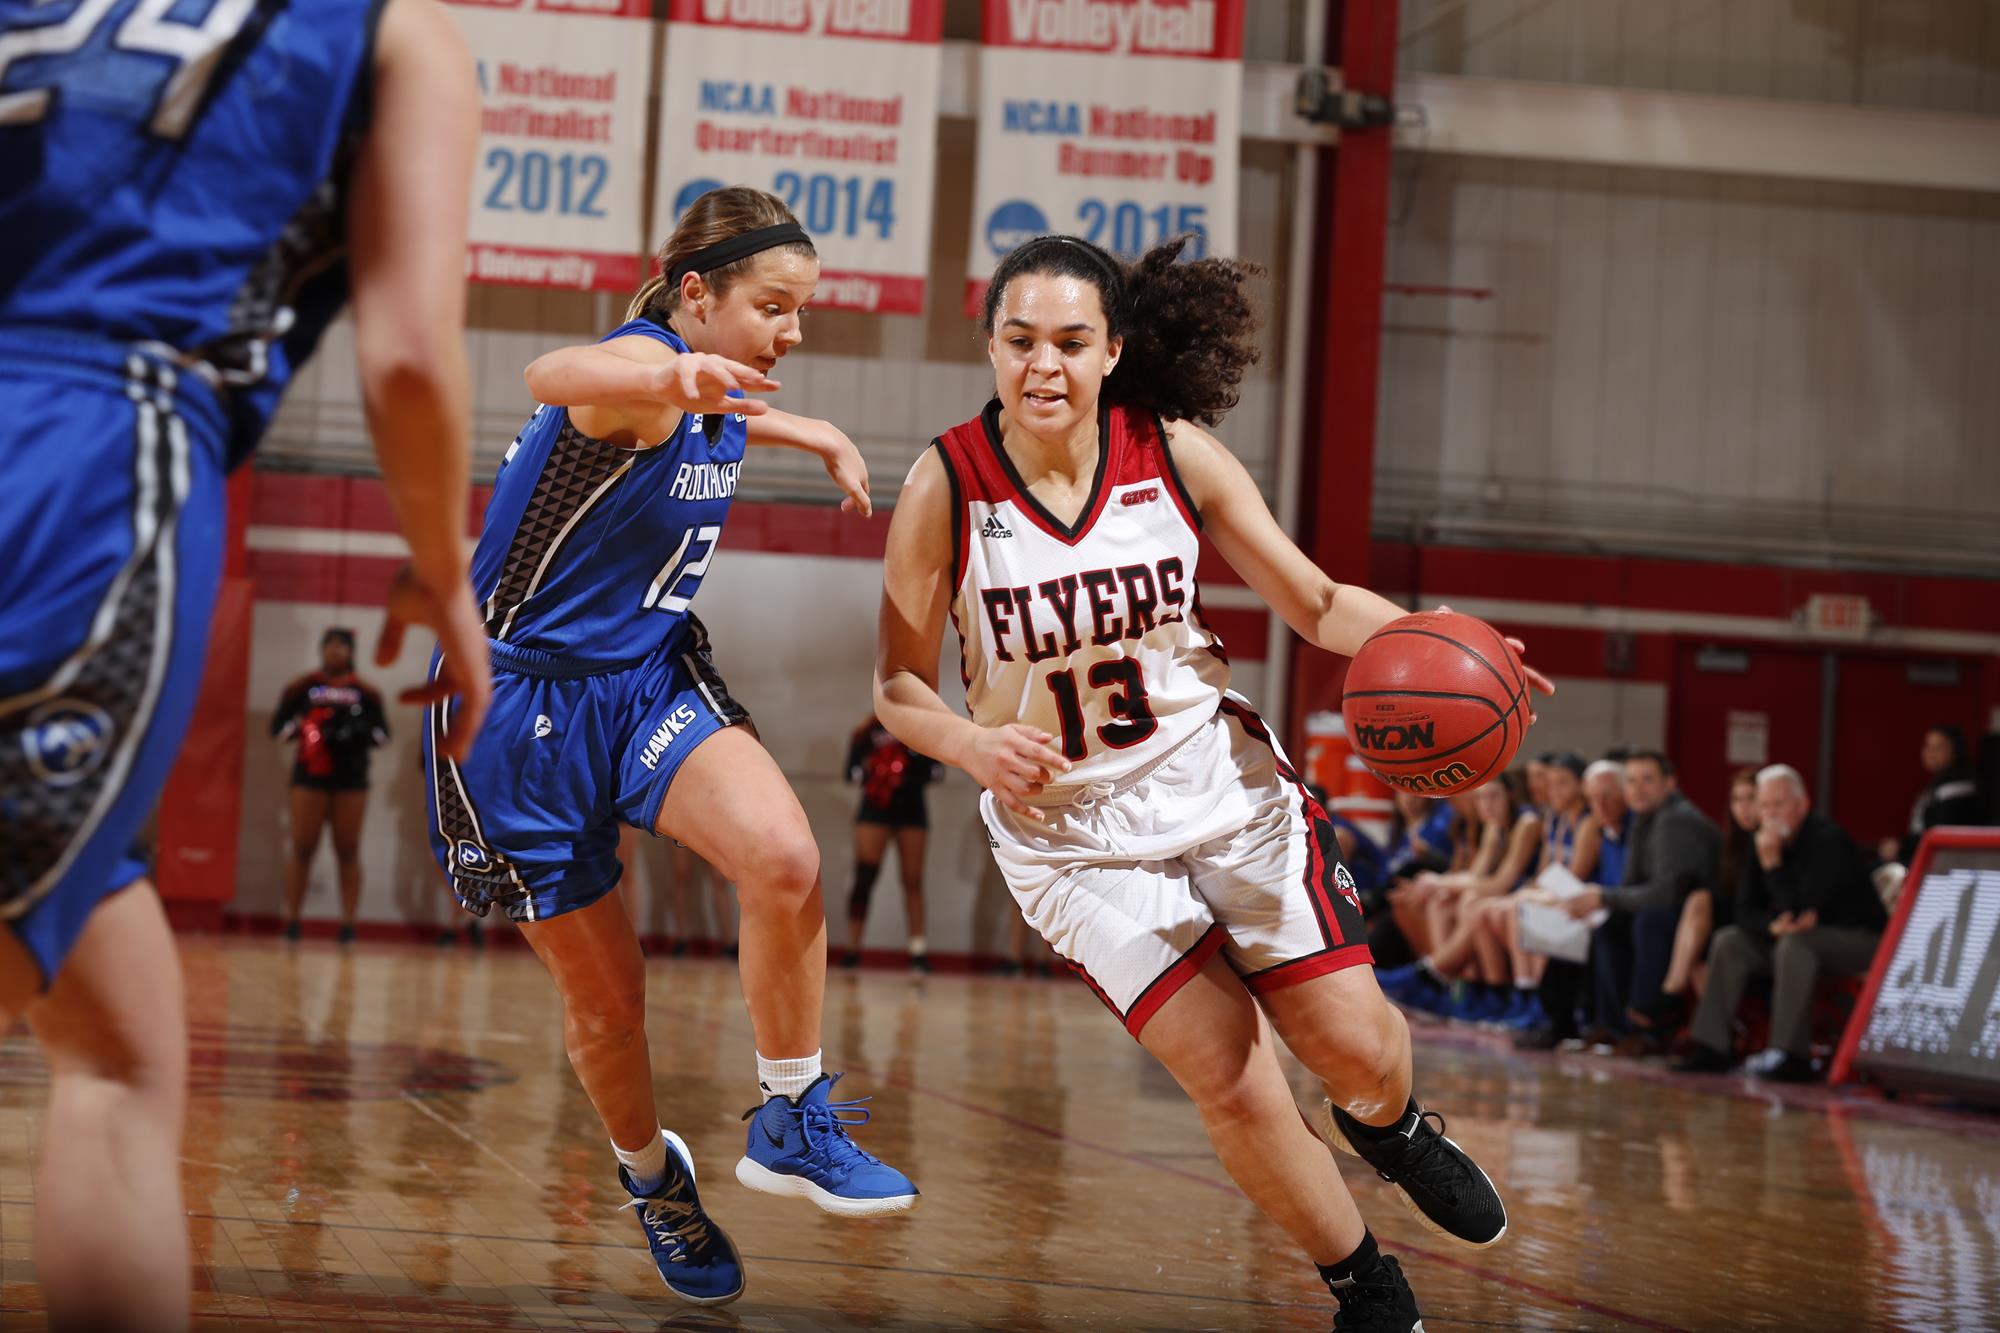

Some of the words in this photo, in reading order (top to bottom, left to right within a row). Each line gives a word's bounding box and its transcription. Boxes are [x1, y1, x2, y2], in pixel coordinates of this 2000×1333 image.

[1008, 0, 1215, 55] Volleyball
[499, 63, 615, 103] National
[700, 79, 775, 116] NCAA
[786, 86, 902, 128] National
[695, 119, 898, 164] Quarterfinalist
[1003, 98, 1082, 137] NCAA
[1089, 103, 1216, 144] National
[484, 148, 609, 219] 2012
[1058, 143, 1167, 180] Runner
[1174, 150, 1213, 186] Up
[774, 171, 896, 240] 2014
[1079, 199, 1206, 262] 2015
[642, 525, 721, 613] 12
[980, 556, 1185, 664] FLYERS
[639, 703, 697, 771] HAWKS
[1045, 655, 1158, 763] 13
[1354, 721, 1435, 751] NCAA
